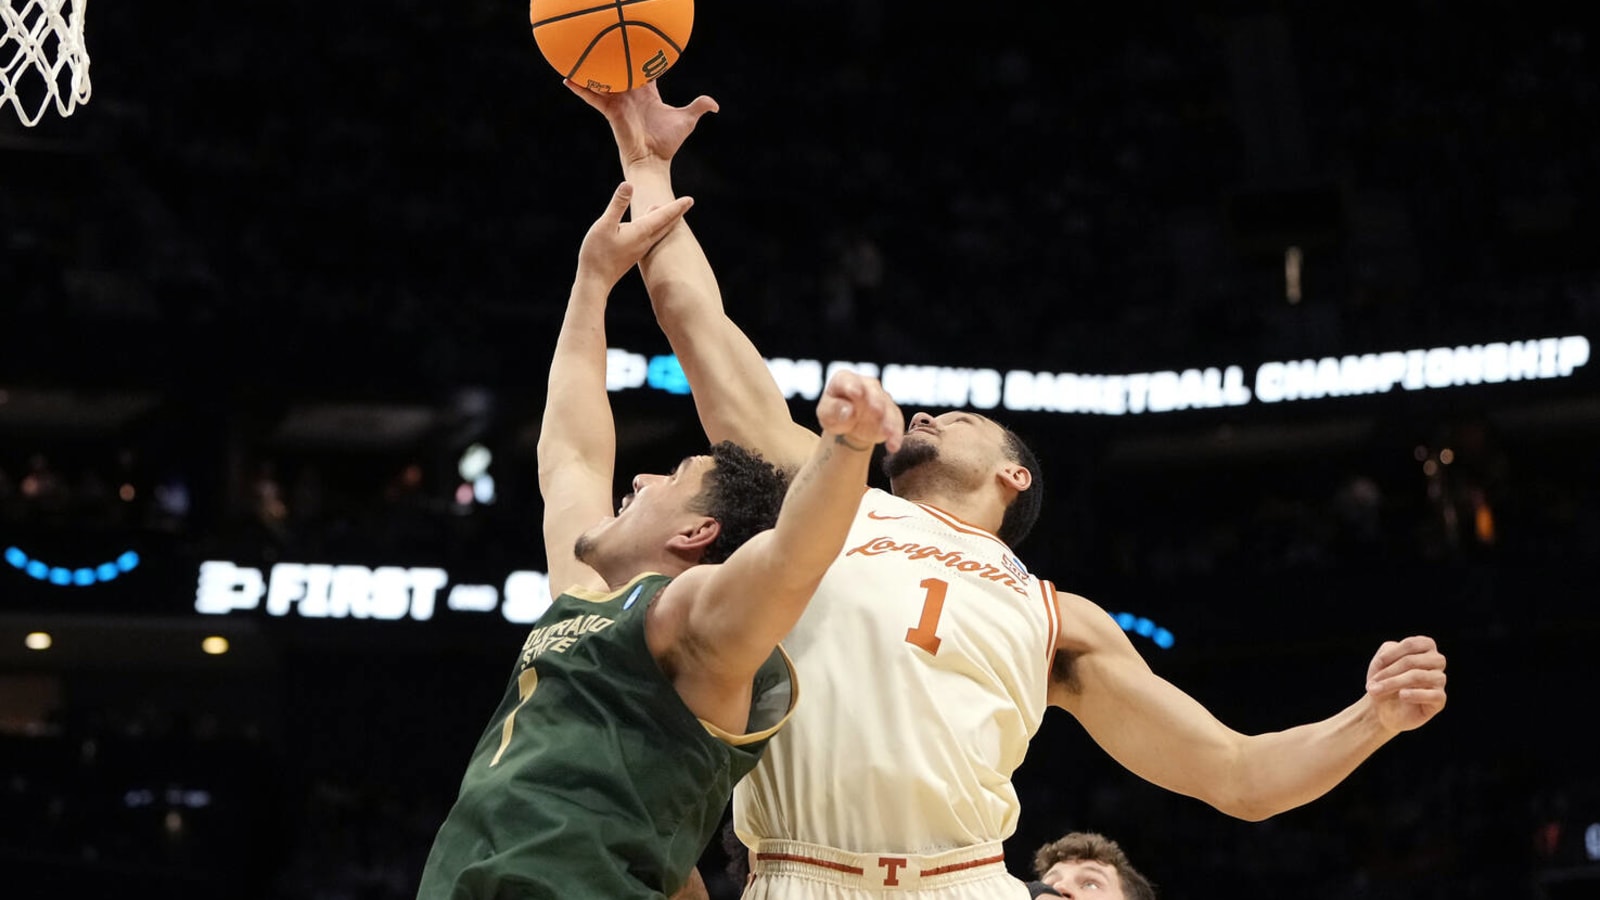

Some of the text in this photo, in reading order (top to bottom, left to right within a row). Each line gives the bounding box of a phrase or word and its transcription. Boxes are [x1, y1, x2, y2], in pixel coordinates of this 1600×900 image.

[1003, 365, 1251, 415] BASKETBALL
[1255, 336, 1589, 402] CHAMPIONSHIP
[267, 563, 448, 620] FIRST
[905, 577, 948, 656] 1
[878, 857, 907, 886] T
